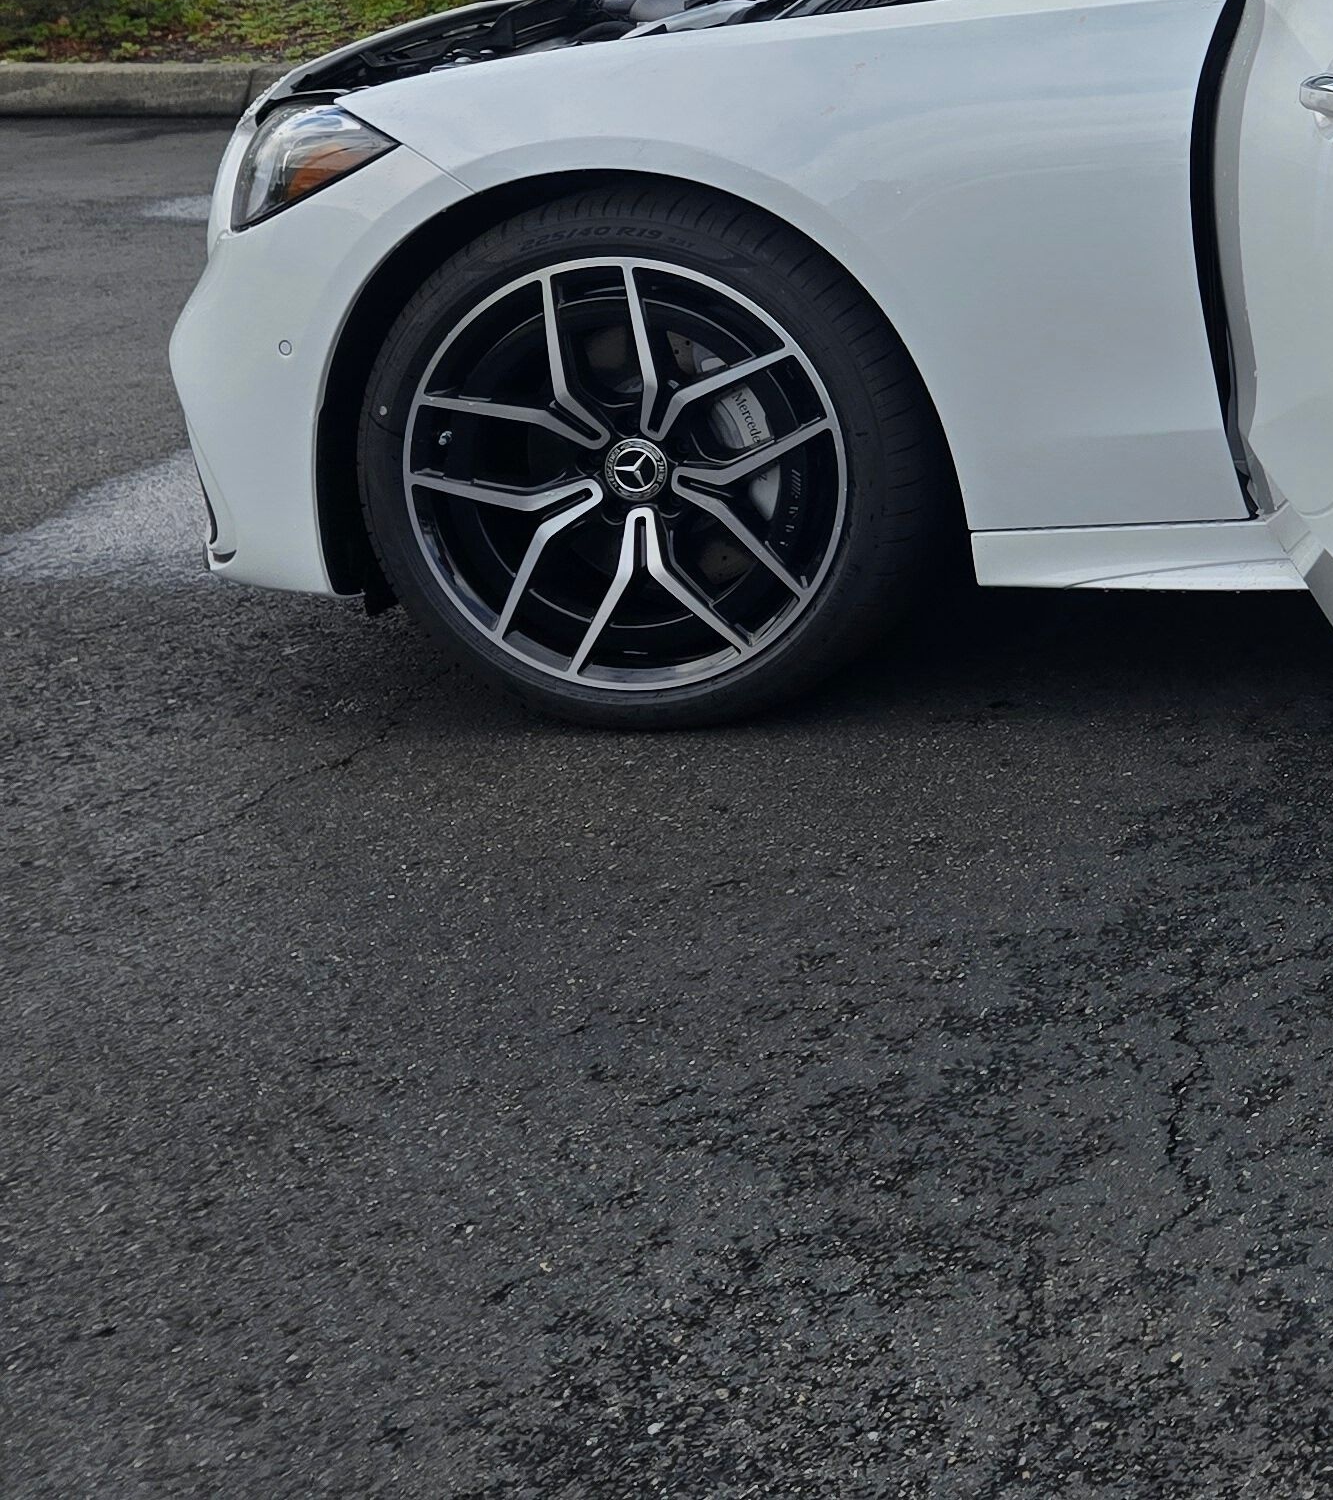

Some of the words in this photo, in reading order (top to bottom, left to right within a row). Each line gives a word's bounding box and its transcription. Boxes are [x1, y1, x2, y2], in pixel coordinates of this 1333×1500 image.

[519, 226, 611, 251] 225/40
[616, 226, 662, 239] R19
[732, 392, 762, 443] Mercede
